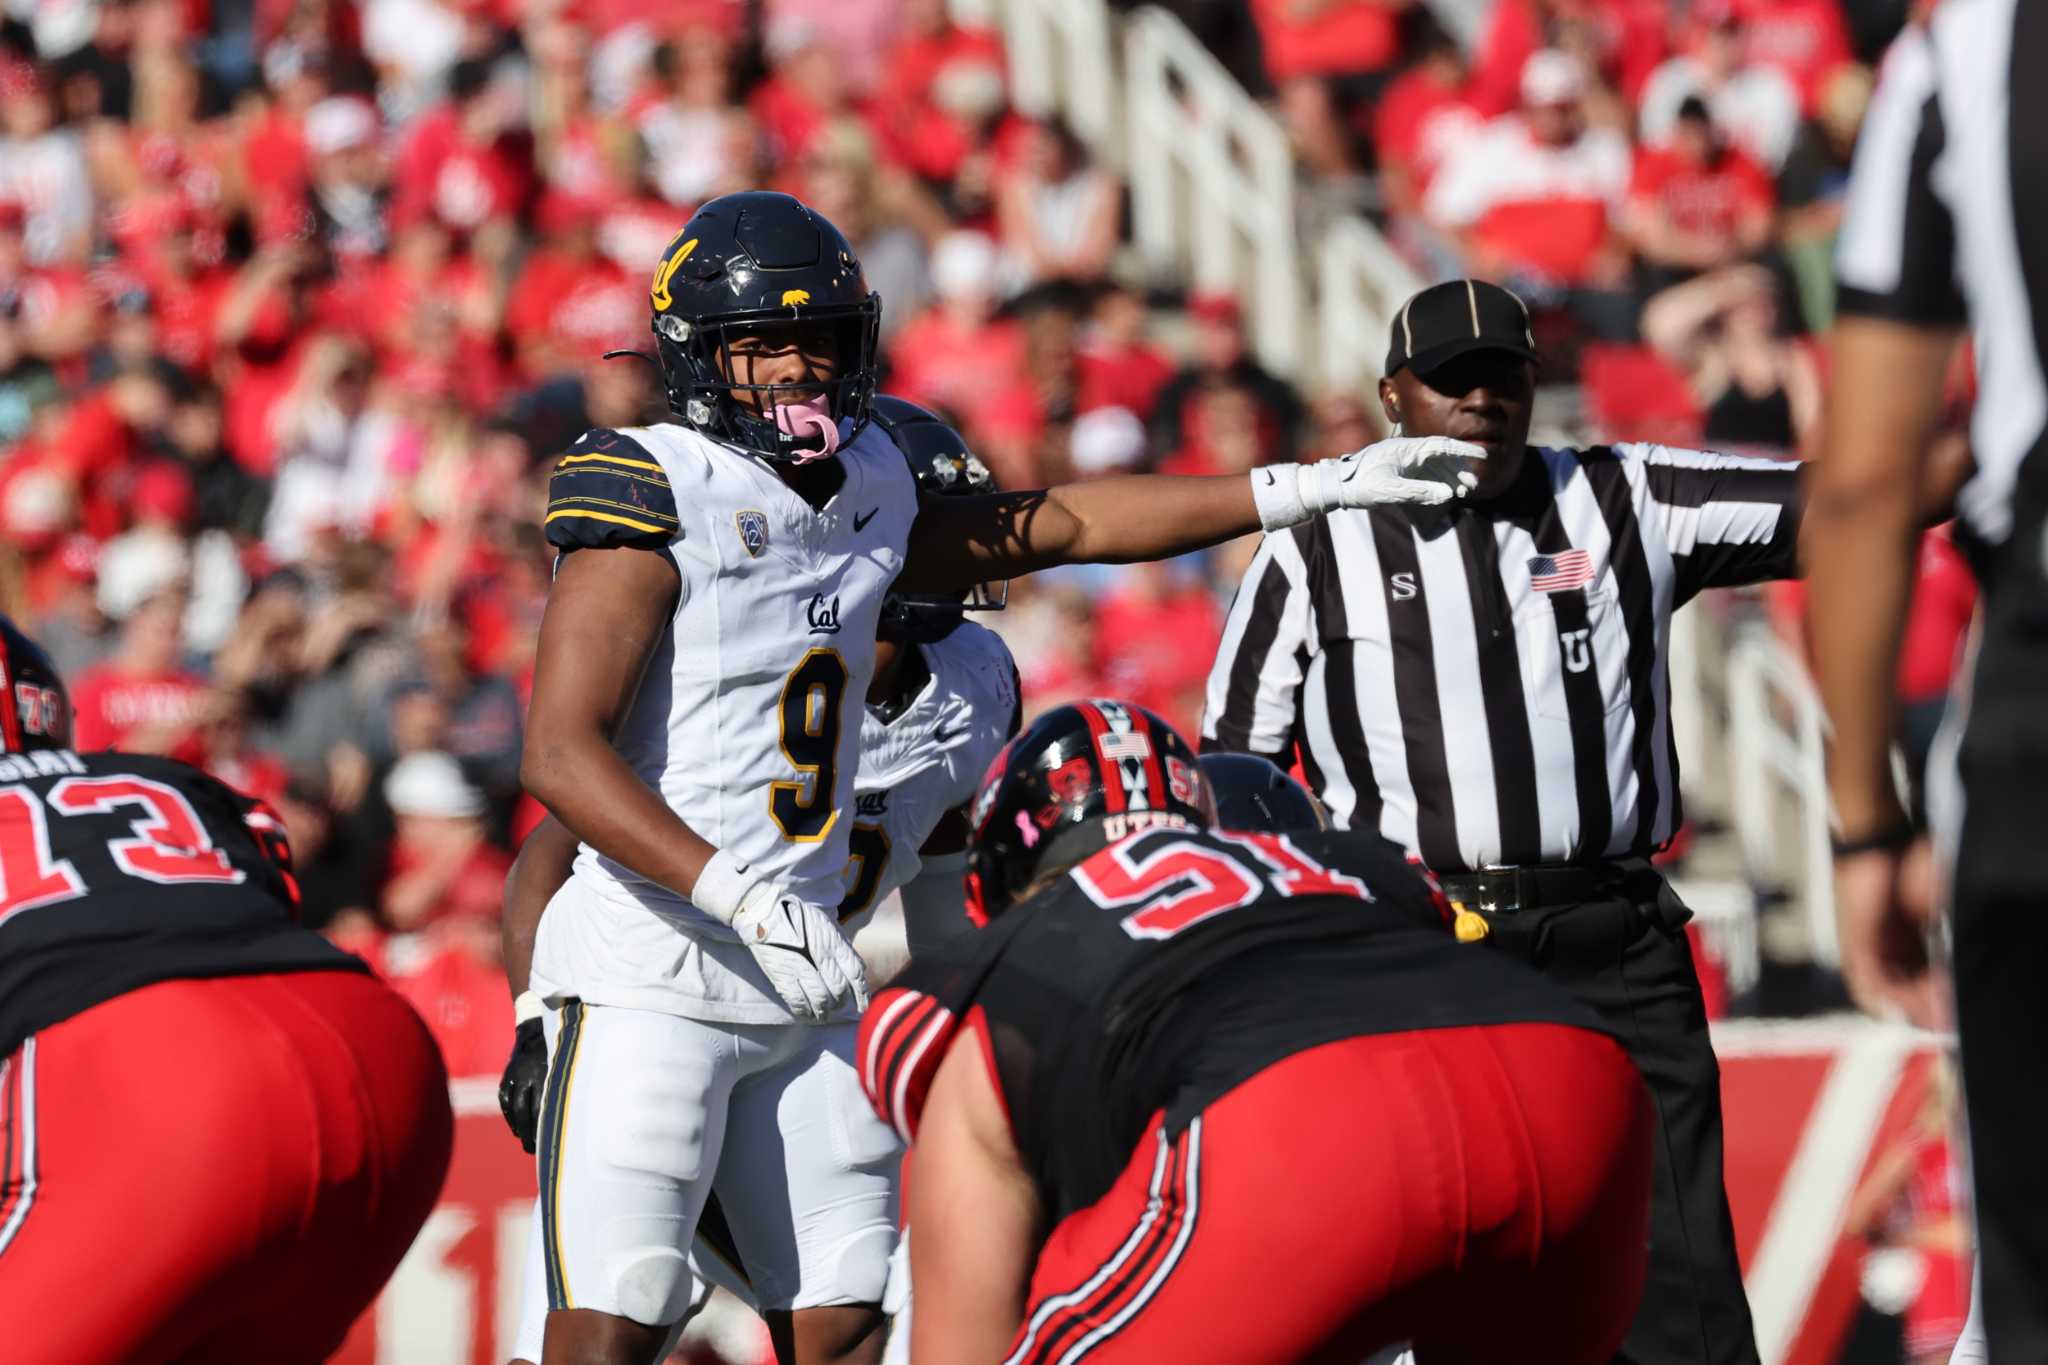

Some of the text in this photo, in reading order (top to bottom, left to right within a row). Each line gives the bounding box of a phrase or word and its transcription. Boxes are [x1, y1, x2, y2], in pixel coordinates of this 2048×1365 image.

[1391, 572, 1417, 601] S
[808, 592, 841, 635] Cal
[1560, 629, 1590, 673] U
[768, 647, 848, 842] 9
[1069, 825, 1376, 940] 51
